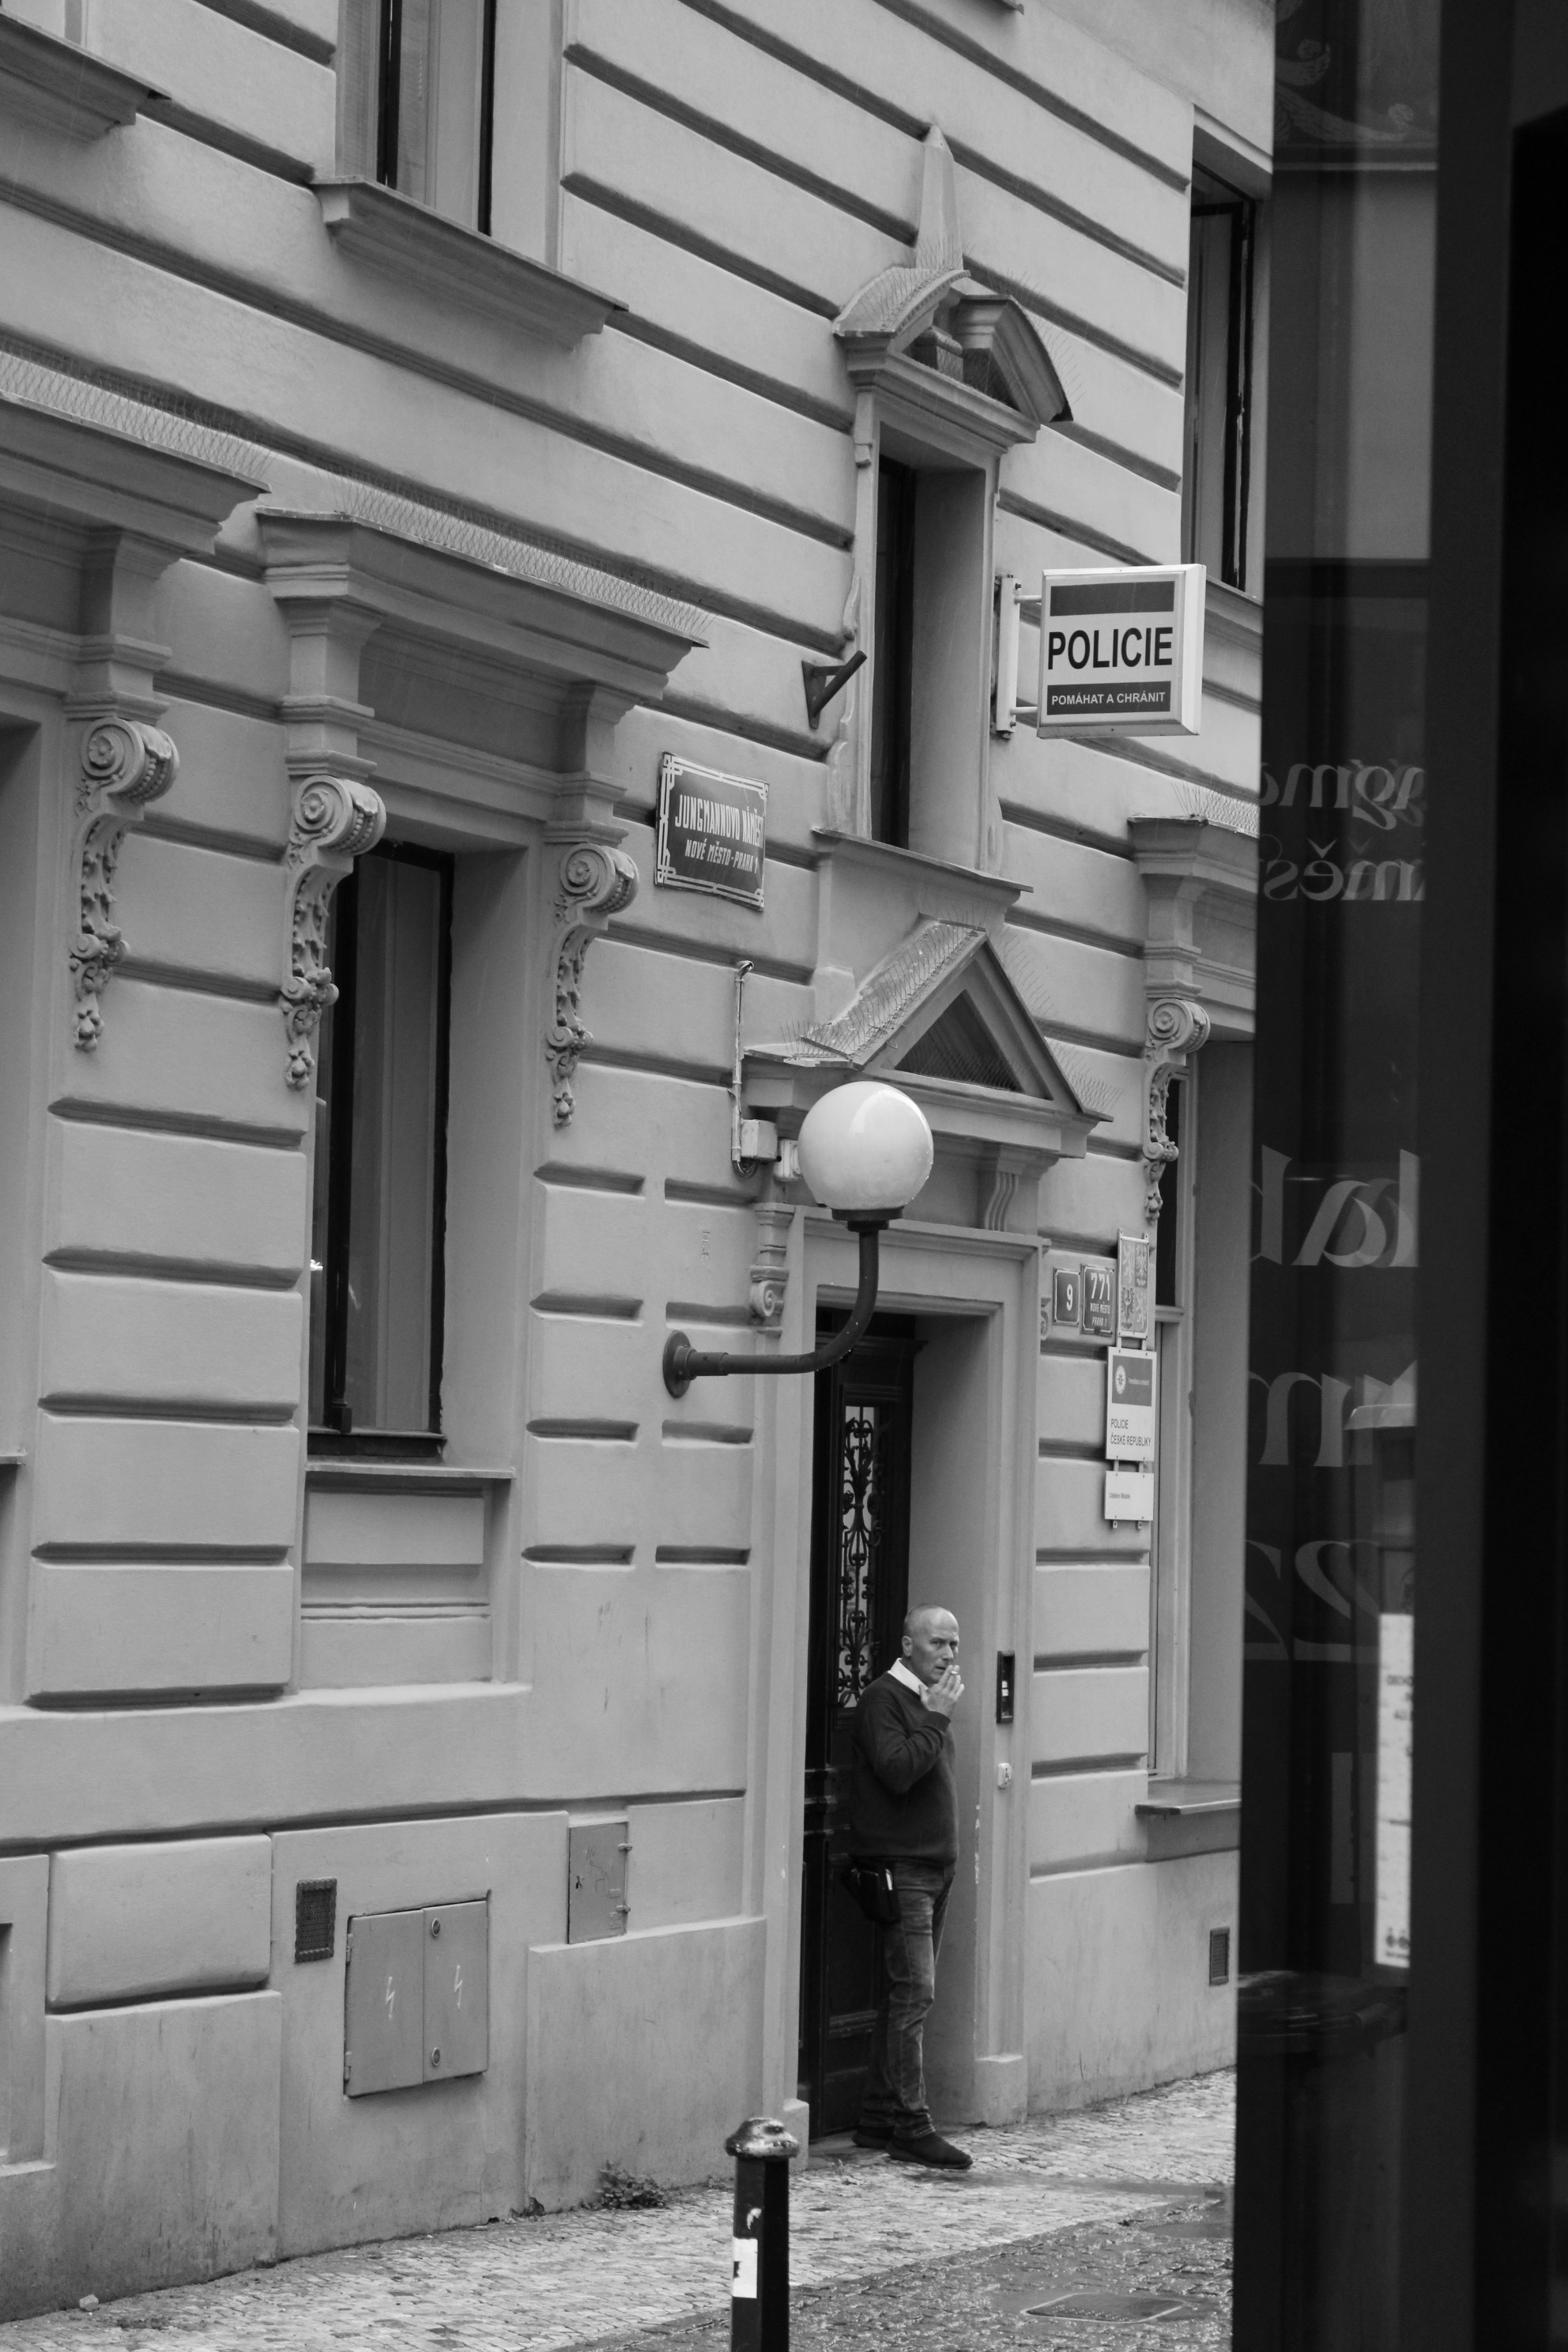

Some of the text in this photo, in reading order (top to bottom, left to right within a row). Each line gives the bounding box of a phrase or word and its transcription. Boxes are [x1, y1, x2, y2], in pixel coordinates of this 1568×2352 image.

[1047, 627, 1174, 670] POLICIE
[1052, 691, 1166, 705] POMÁHAT A CHRÁNIT
[675, 794, 740, 840] JUNGMANNOVO
[685, 839, 707, 860] NOVÉ
[708, 841, 731, 865] MĚSTO
[733, 851, 753, 872] PRAHA
[754, 856, 759, 874] 1
[1066, 1283, 1073, 1311] 9
[1091, 1272, 1110, 1301] 771
[1110, 1418, 1129, 1429] POLICIE
[1110, 1431, 1152, 1447] ČESKÉ REPUBLIKY
